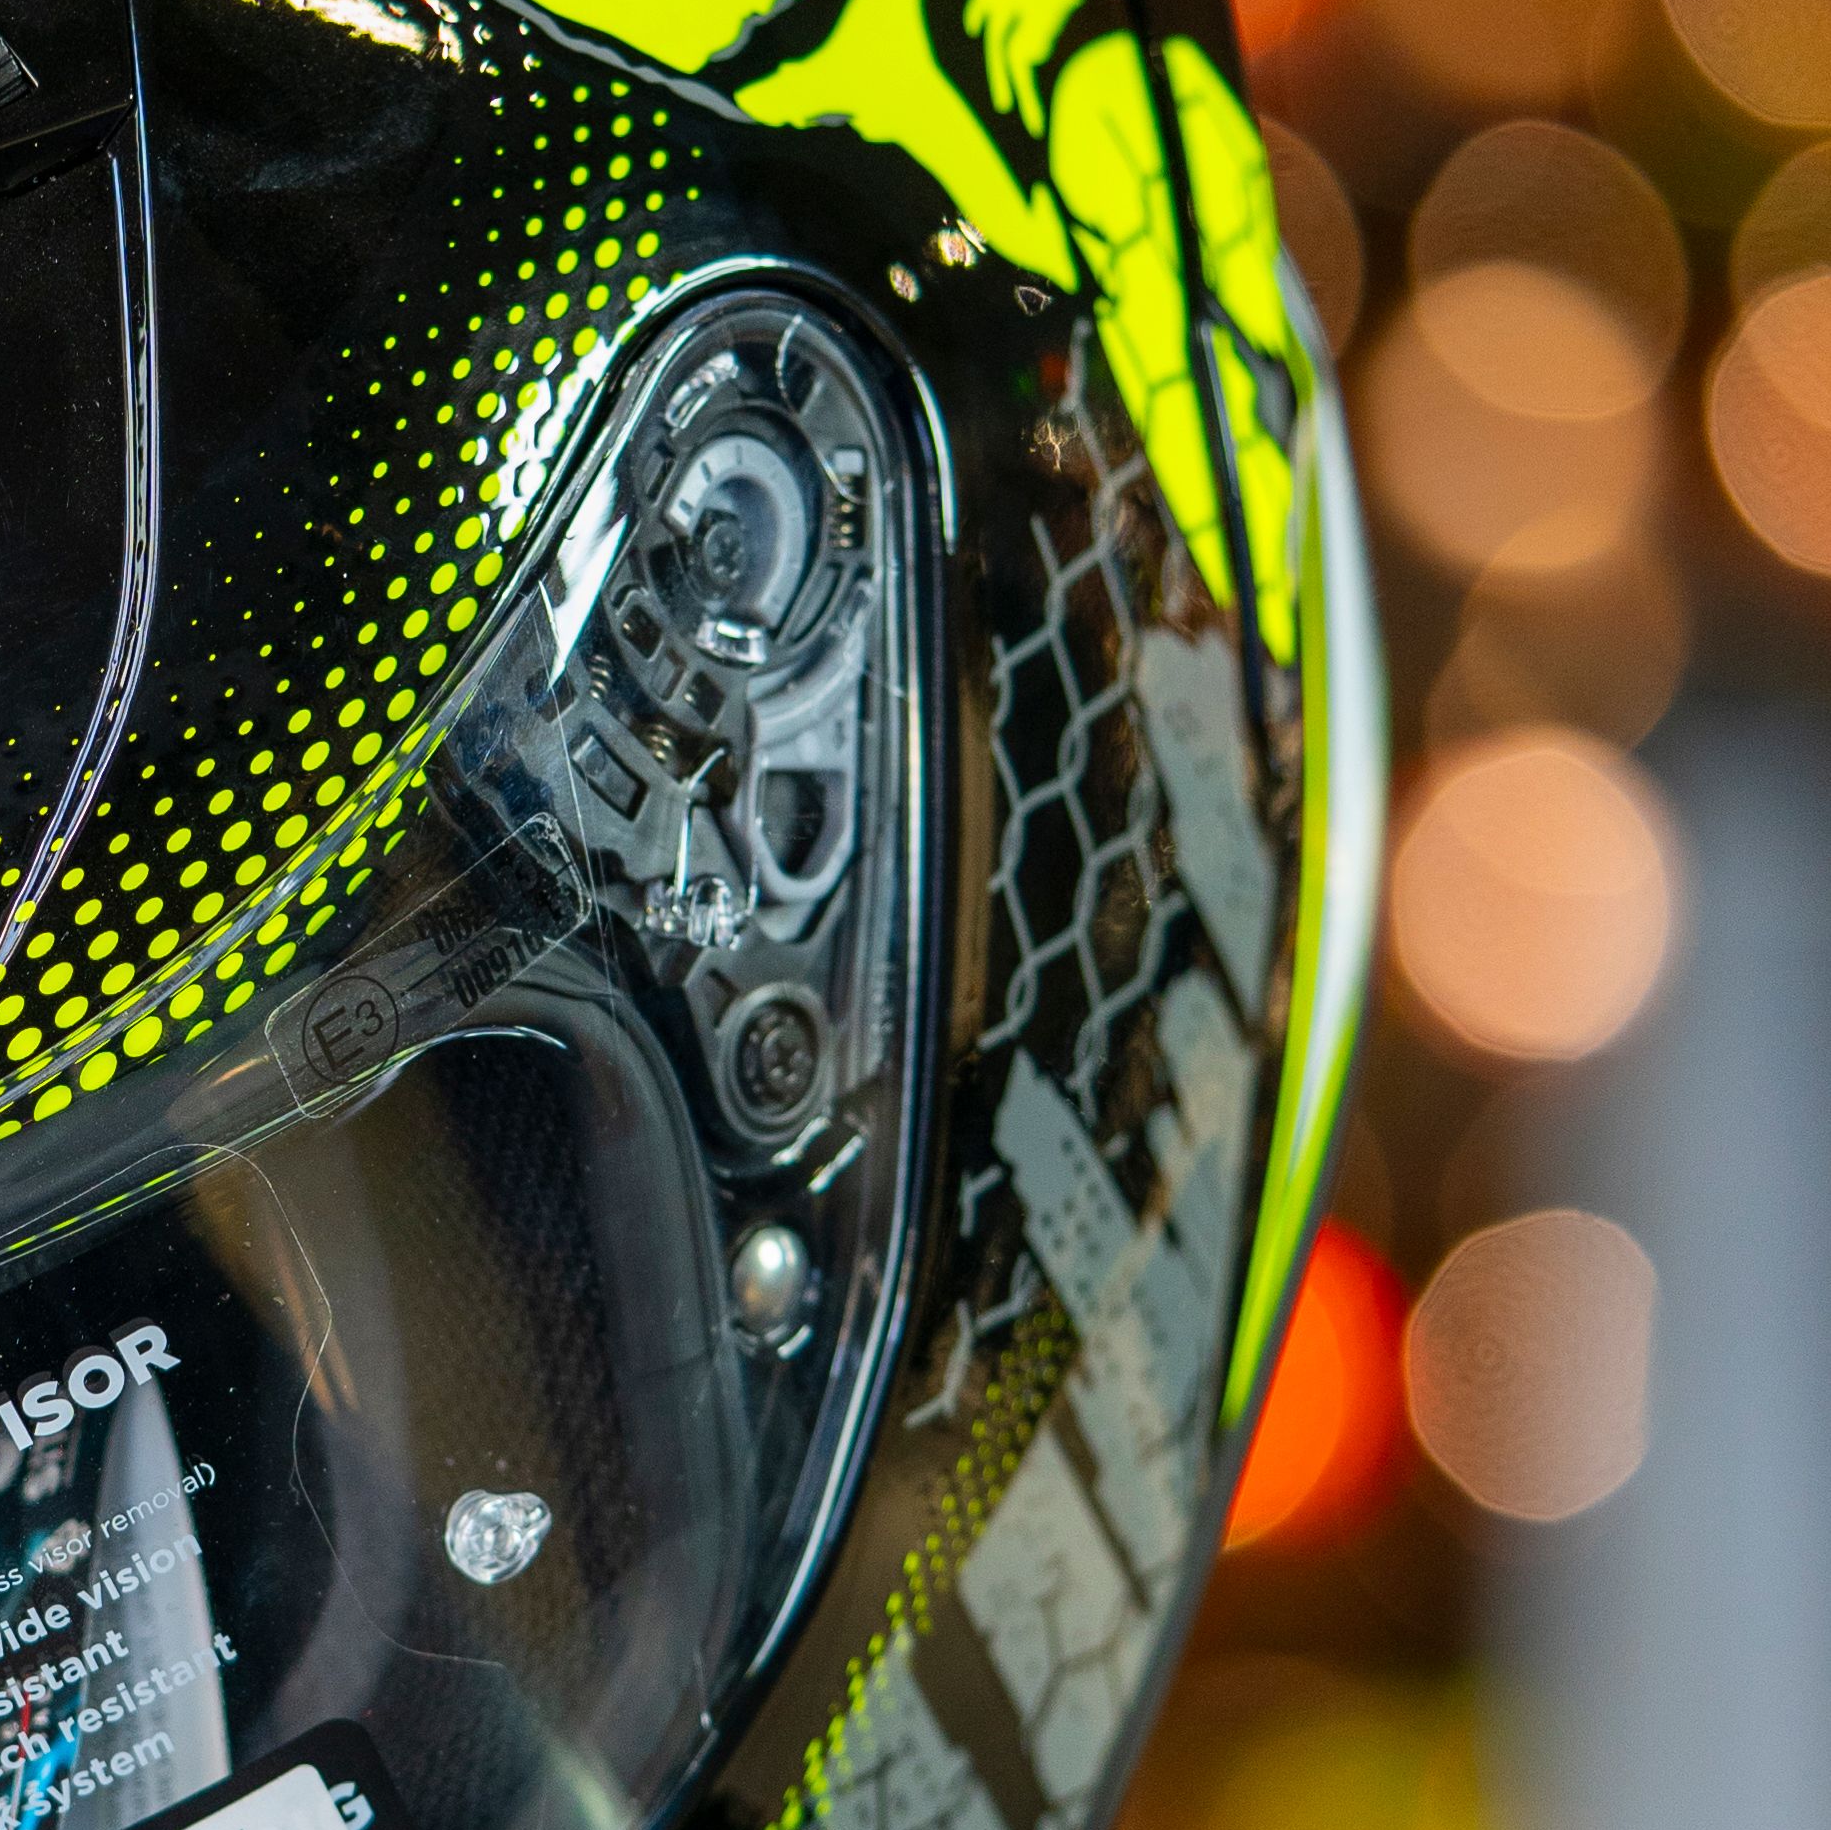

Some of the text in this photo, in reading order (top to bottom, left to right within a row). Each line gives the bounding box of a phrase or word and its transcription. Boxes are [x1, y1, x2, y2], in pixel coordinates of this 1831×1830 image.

[27, 1528, 98, 1573] visor
[98, 1462, 217, 1536] removal)
[77, 1530, 201, 1609] vision
[56, 1632, 237, 1743] resistant
[25, 1729, 175, 1823] system
